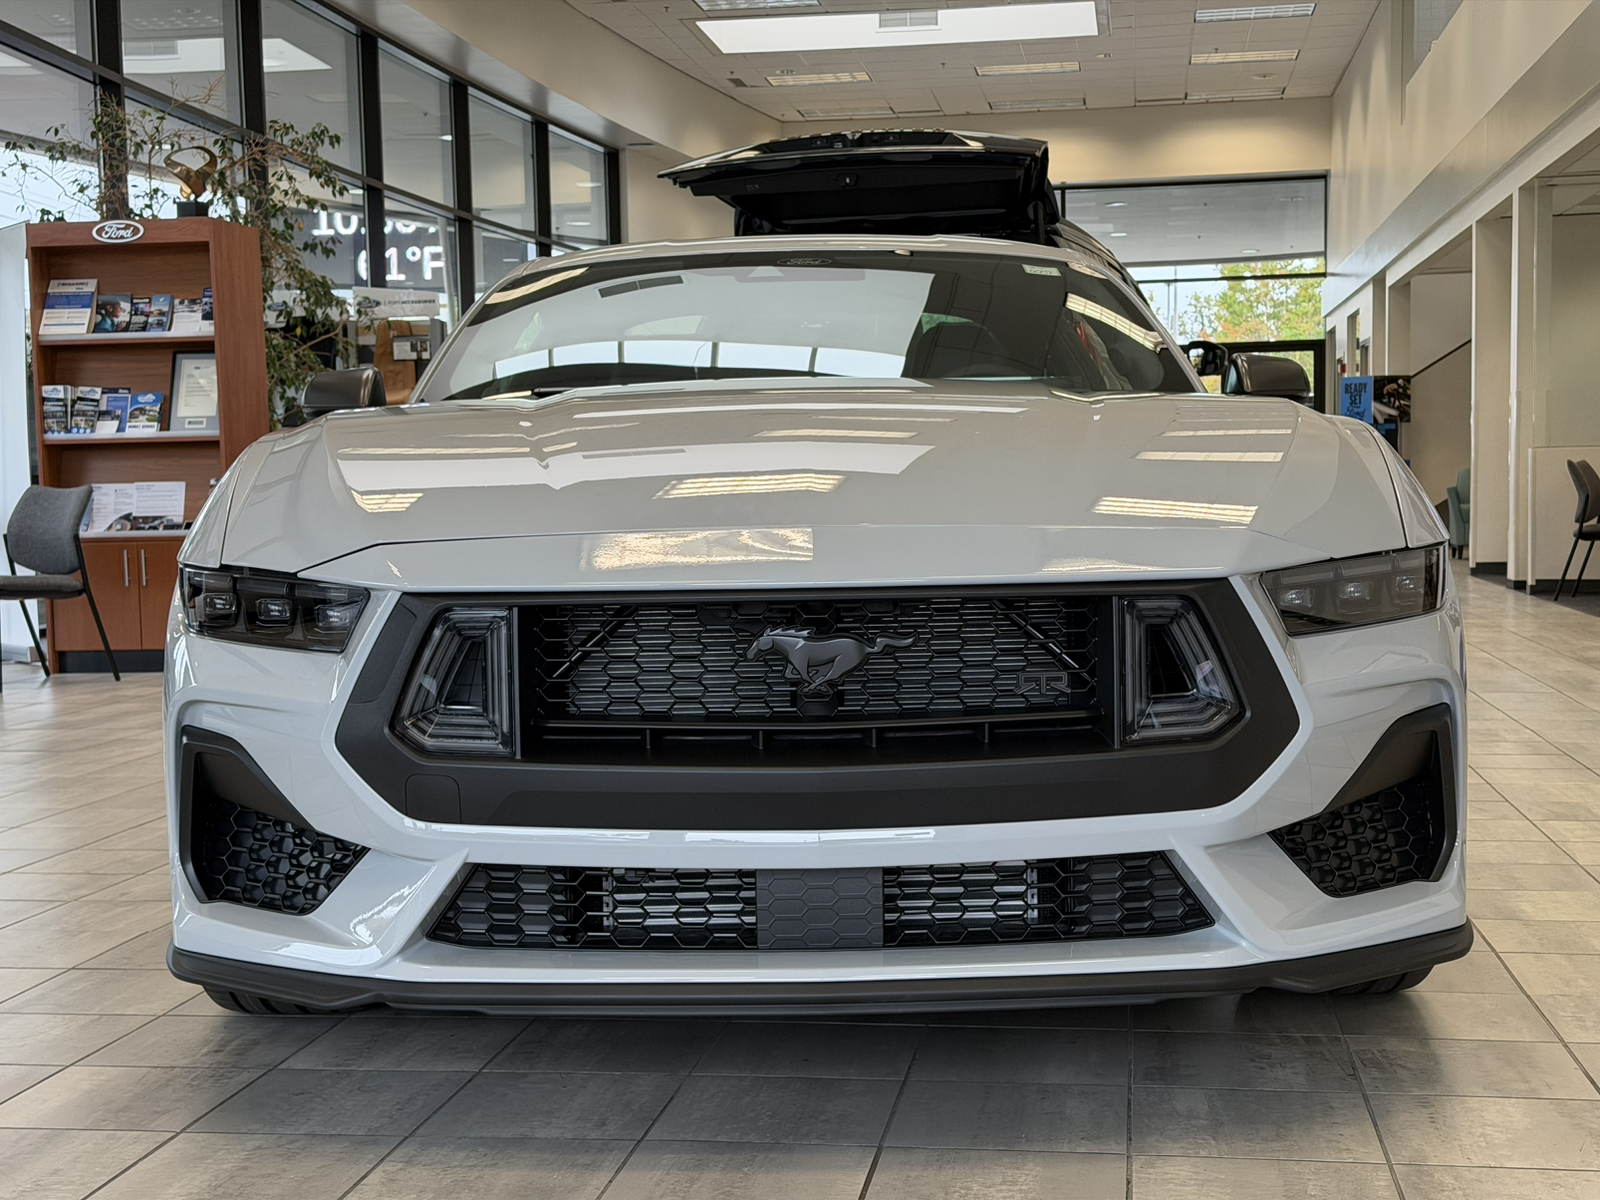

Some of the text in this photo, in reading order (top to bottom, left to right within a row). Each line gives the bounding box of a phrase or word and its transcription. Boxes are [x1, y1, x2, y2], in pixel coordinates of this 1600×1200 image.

[102, 224, 134, 239] Ford
[1344, 382, 1367, 394] READY
[1349, 394, 1362, 405] SET
[1014, 672, 1071, 695] RTR
